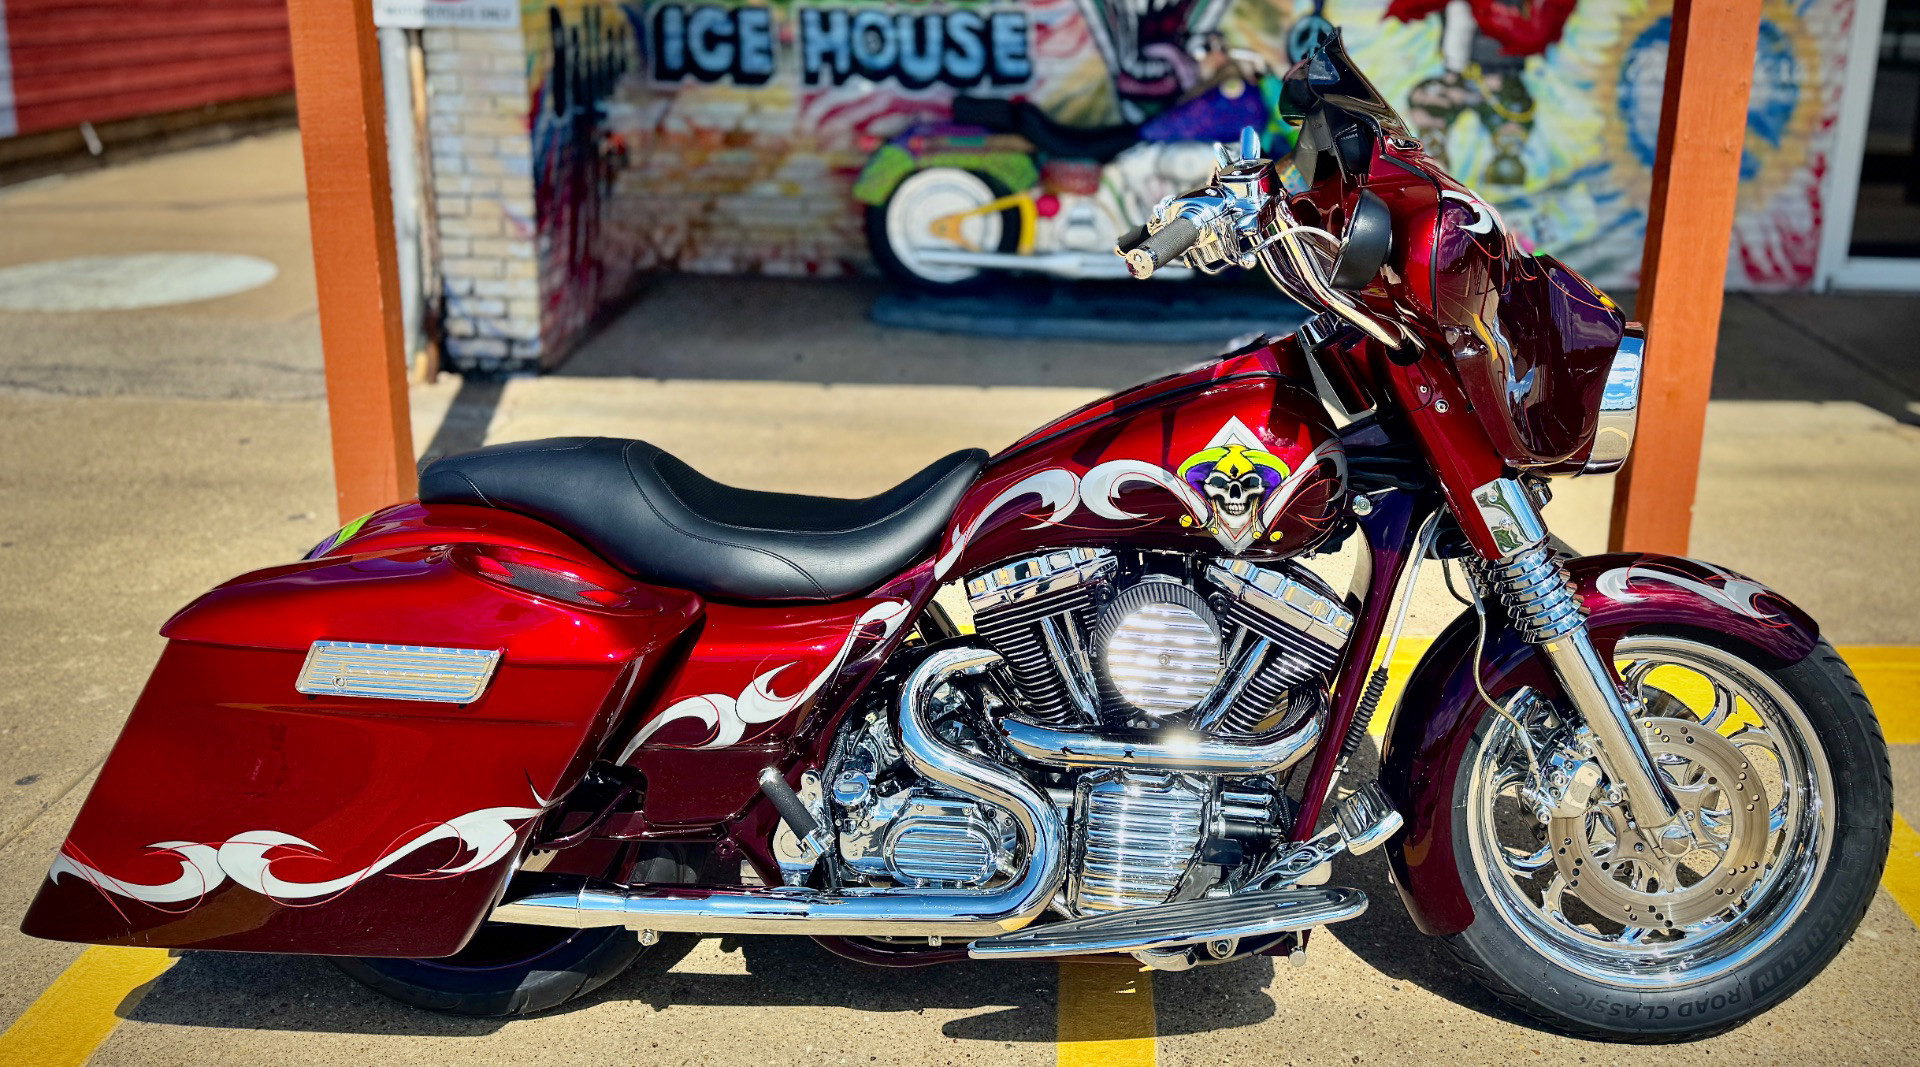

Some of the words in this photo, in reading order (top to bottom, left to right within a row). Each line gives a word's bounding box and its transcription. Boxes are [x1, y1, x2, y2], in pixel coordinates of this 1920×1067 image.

[655, 6, 774, 83] ICE
[801, 9, 1032, 87] HOUSE
[1756, 883, 1850, 992] MICHELIN
[1569, 991, 1669, 1020] CLASSIC
[1678, 986, 1743, 1018] ROAD
